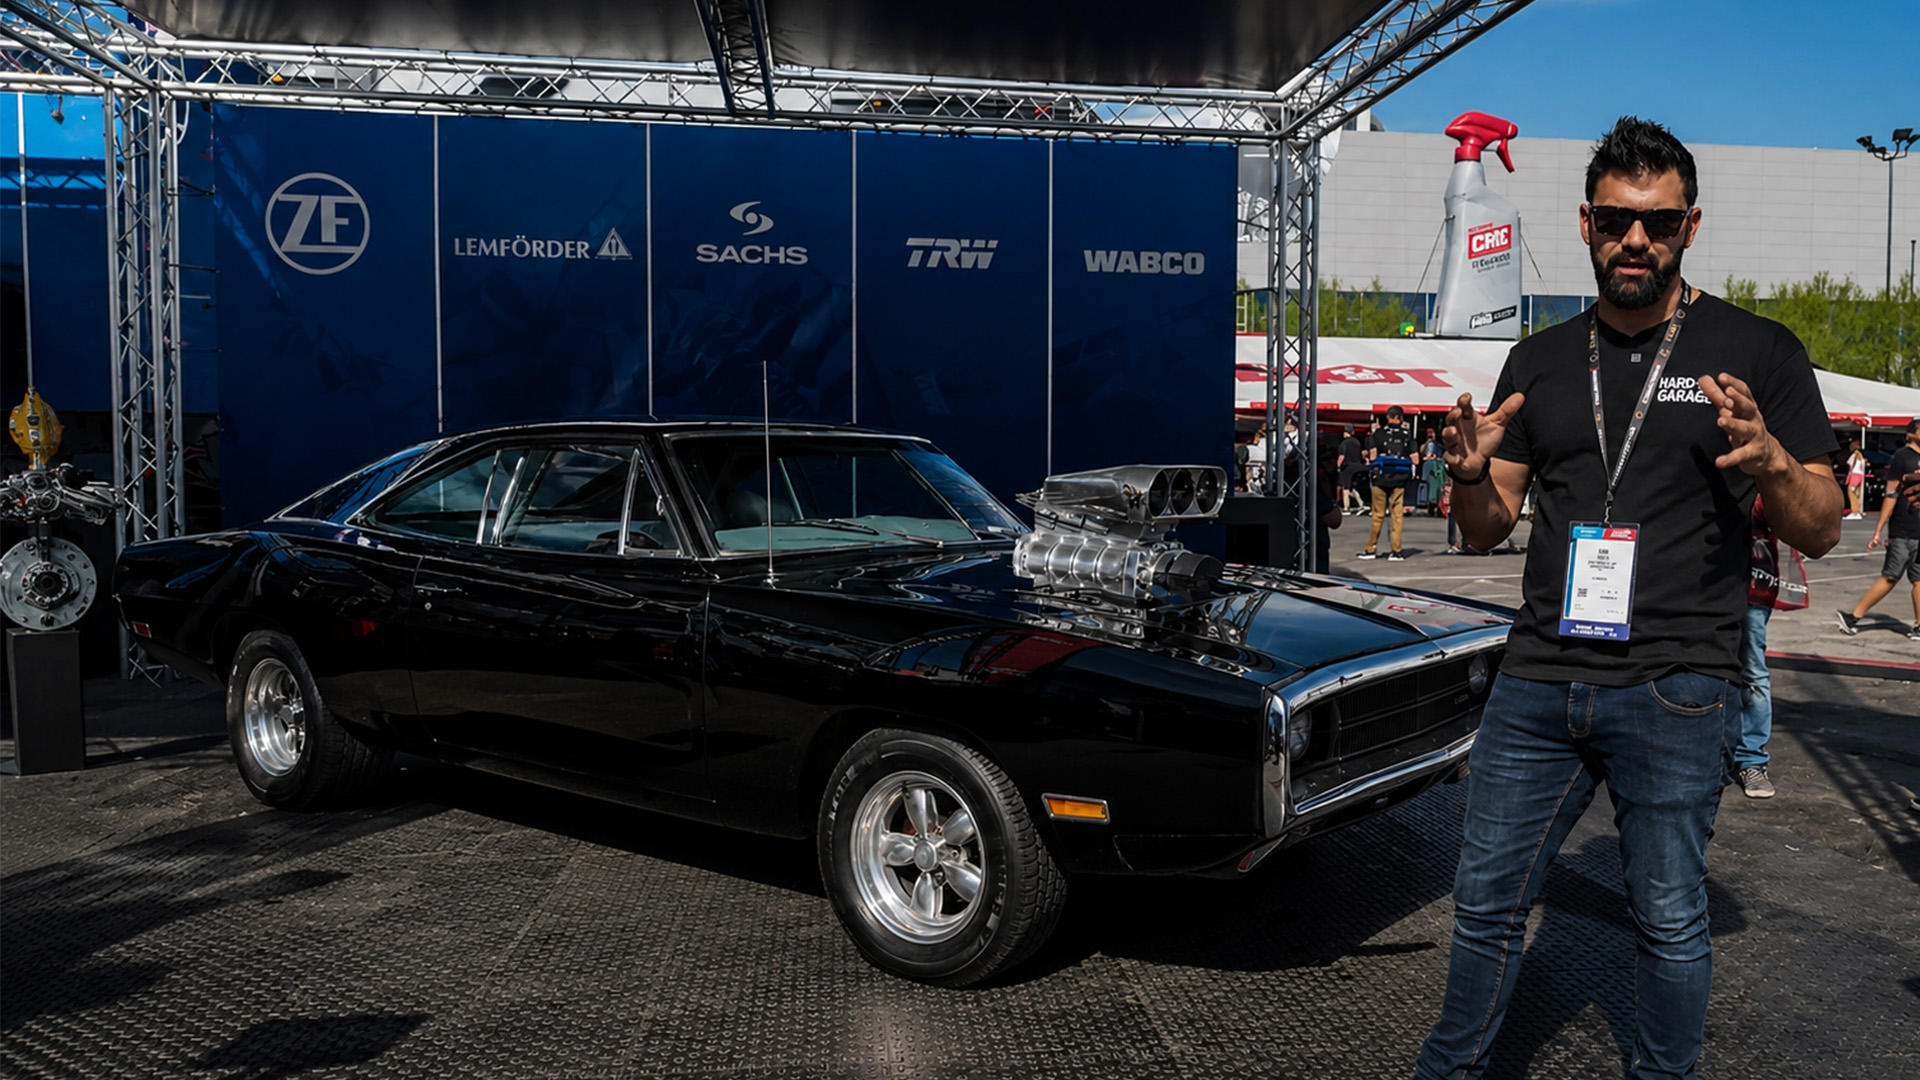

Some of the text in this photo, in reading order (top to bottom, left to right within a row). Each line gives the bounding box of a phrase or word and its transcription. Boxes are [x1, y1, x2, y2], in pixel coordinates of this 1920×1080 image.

[272, 190, 364, 256] ZF
[454, 234, 590, 259] LEMFÖRDER
[696, 244, 808, 265] SACHS
[906, 237, 999, 269] TRW
[1084, 249, 1205, 275] WABCO
